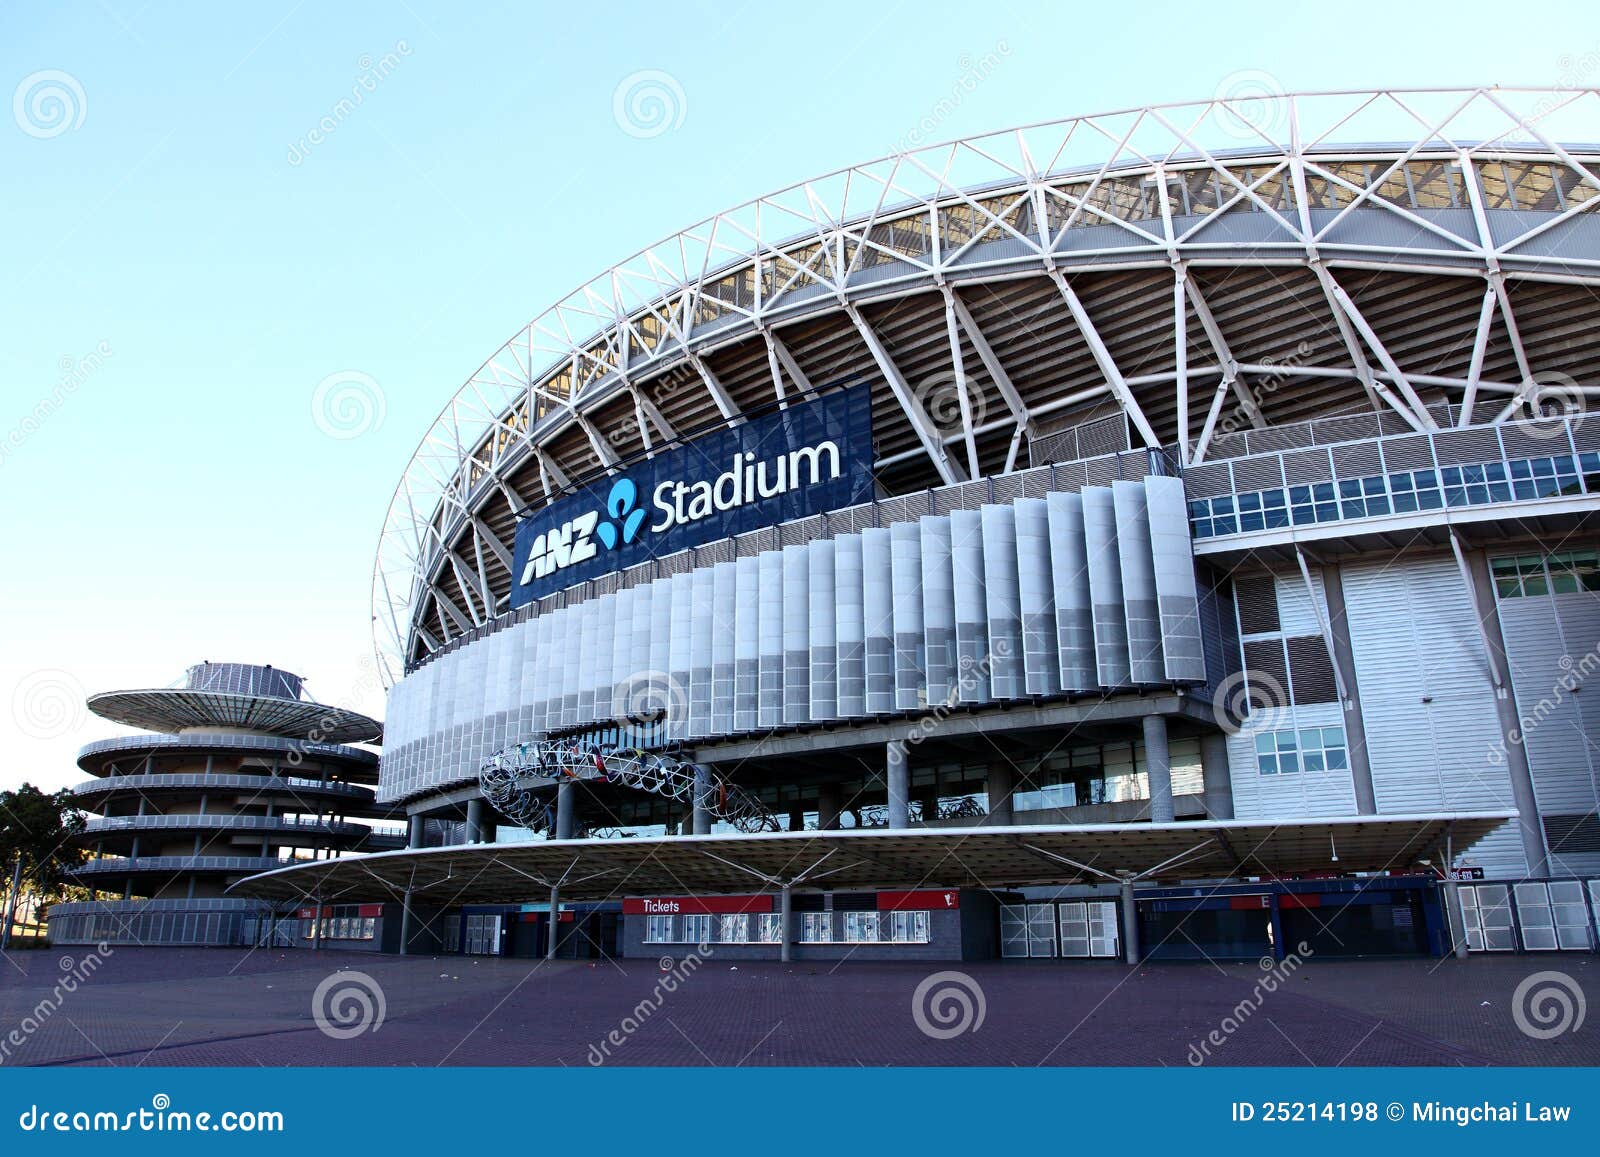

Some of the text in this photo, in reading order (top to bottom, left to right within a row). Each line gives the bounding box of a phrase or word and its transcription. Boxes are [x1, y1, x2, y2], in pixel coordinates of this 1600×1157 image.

[519, 440, 841, 586] ANZ Stadium
[643, 899, 680, 912] Tickets
